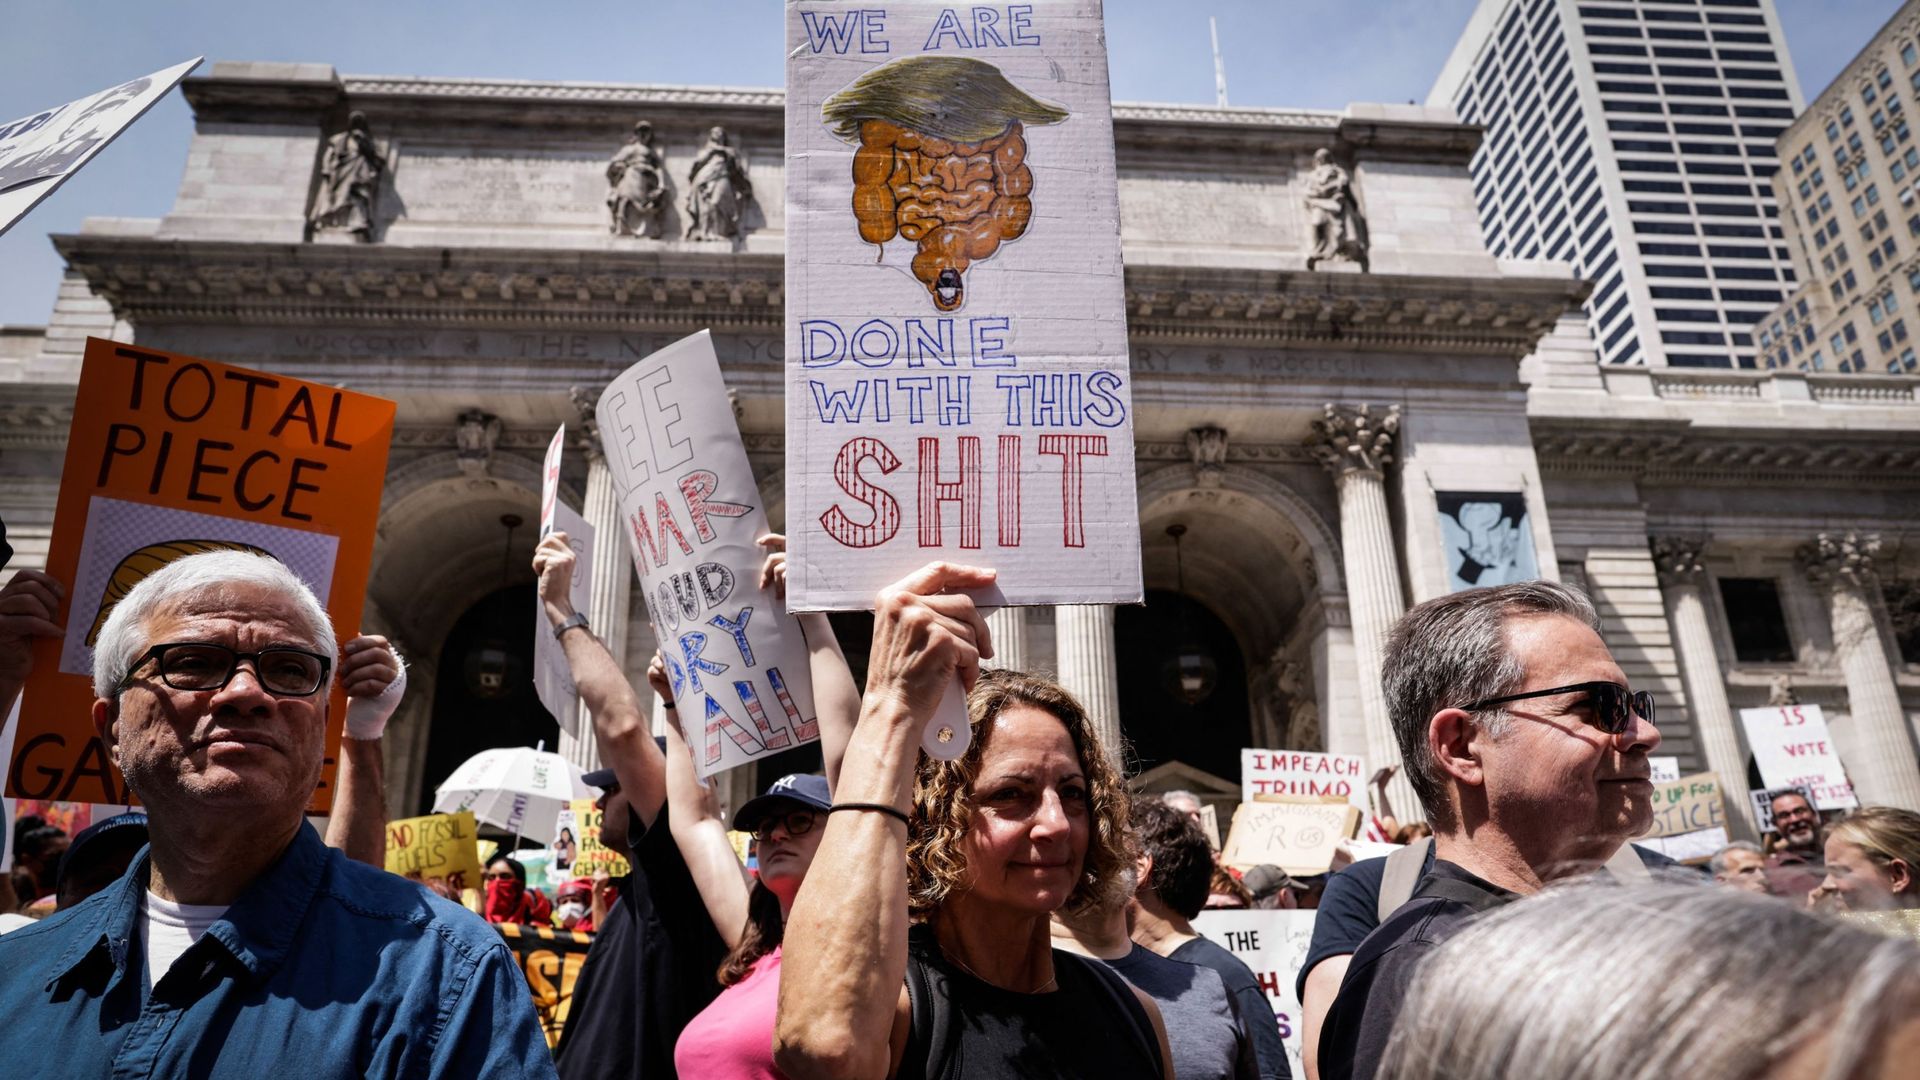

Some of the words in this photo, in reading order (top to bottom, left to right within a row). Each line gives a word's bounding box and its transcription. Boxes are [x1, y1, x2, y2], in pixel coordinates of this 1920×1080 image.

[800, 9, 890, 54] WE
[922, 4, 1041, 51] ARE
[515, 334, 590, 357] THE
[800, 316, 1017, 369] DONE
[114, 347, 352, 452] TOTAL
[809, 376, 972, 426] WITH
[996, 371, 1126, 428] THIS
[600, 364, 694, 502] EE
[96, 423, 328, 522] PIECE
[818, 434, 1109, 550] SHIT
[630, 469, 755, 578] MAR
[649, 562, 736, 642] OUD
[703, 666, 821, 768] ALL
[1252, 754, 1360, 776] IMPEACH
[1782, 740, 1829, 757] VOTE
[1666, 785, 1686, 804] UP
[1689, 782, 1715, 799] FOR
[396, 844, 447, 871] FUELS
[1265, 824, 1288, 851] R
[1224, 930, 1261, 952] THE
